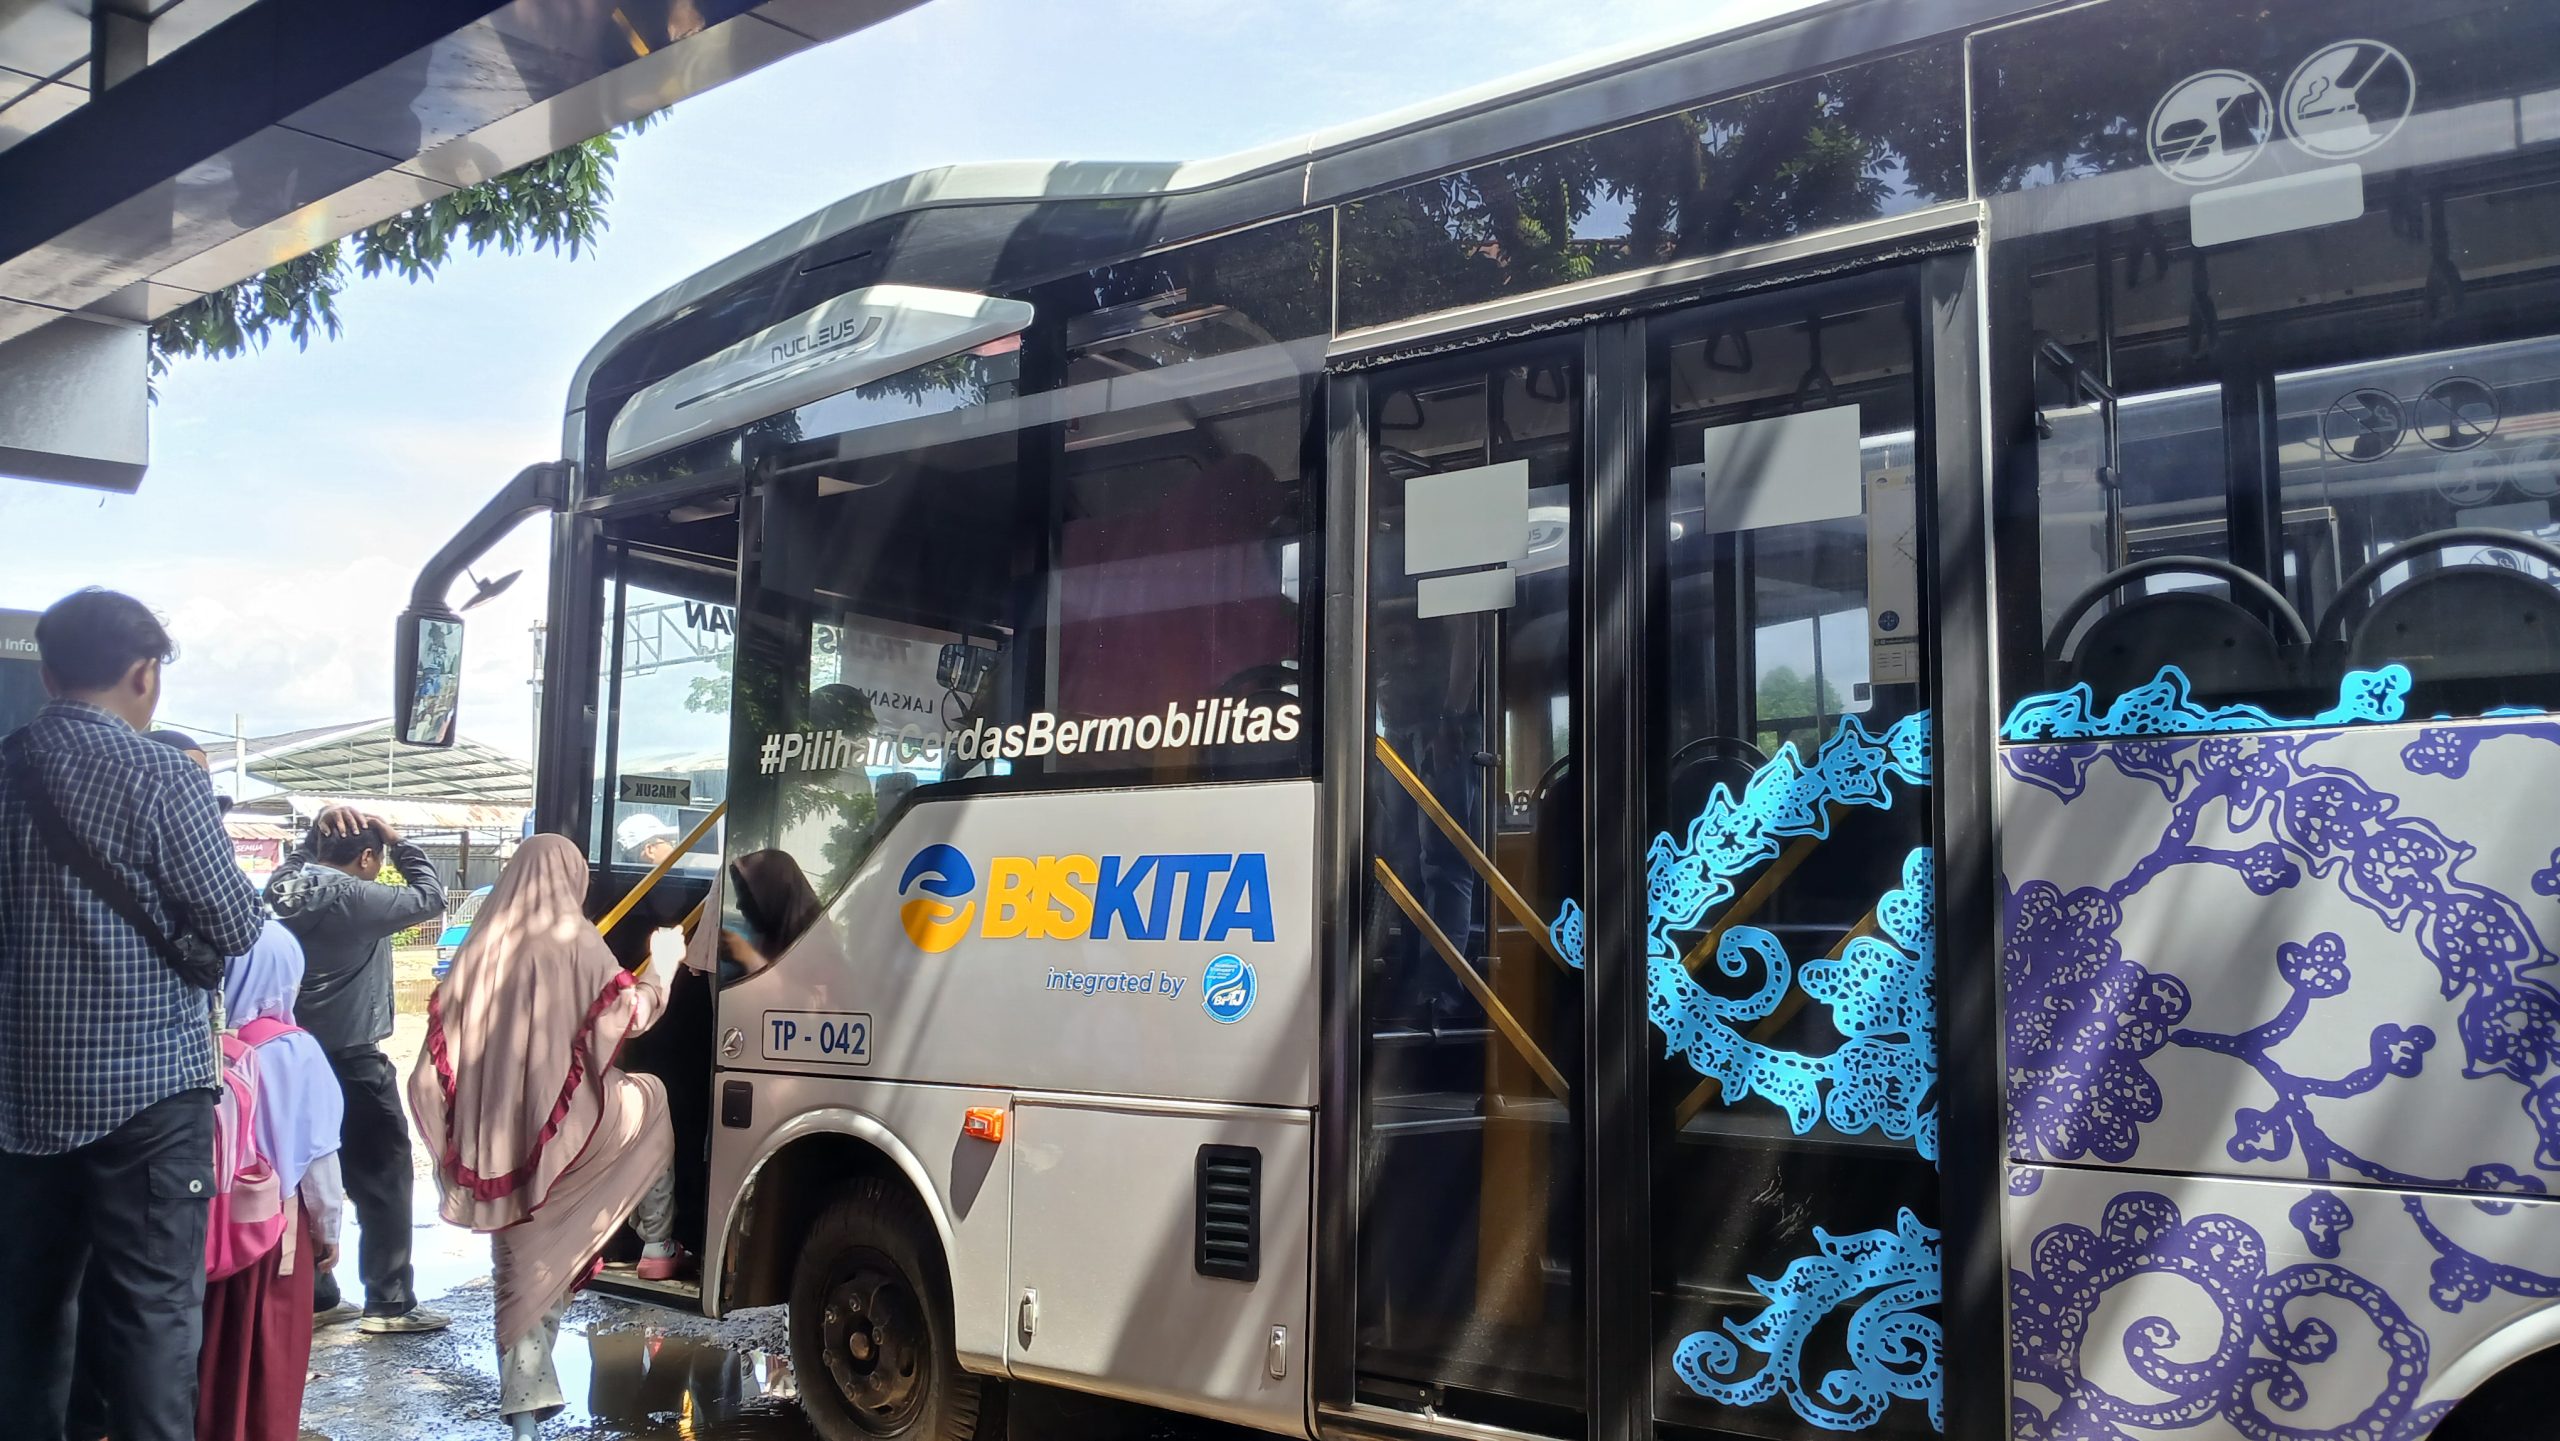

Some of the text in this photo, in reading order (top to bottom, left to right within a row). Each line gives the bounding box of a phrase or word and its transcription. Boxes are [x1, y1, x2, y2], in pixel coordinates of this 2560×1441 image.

[771, 319, 855, 363] NUCLEUS
[760, 700, 1301, 775] #PilihanCerdasBermobilitas
[981, 853, 1276, 942] BISKITA
[1046, 966, 1154, 995] integrated
[1158, 971, 1187, 1000] by
[771, 1020, 797, 1051] TP
[819, 1021, 866, 1055] 042
